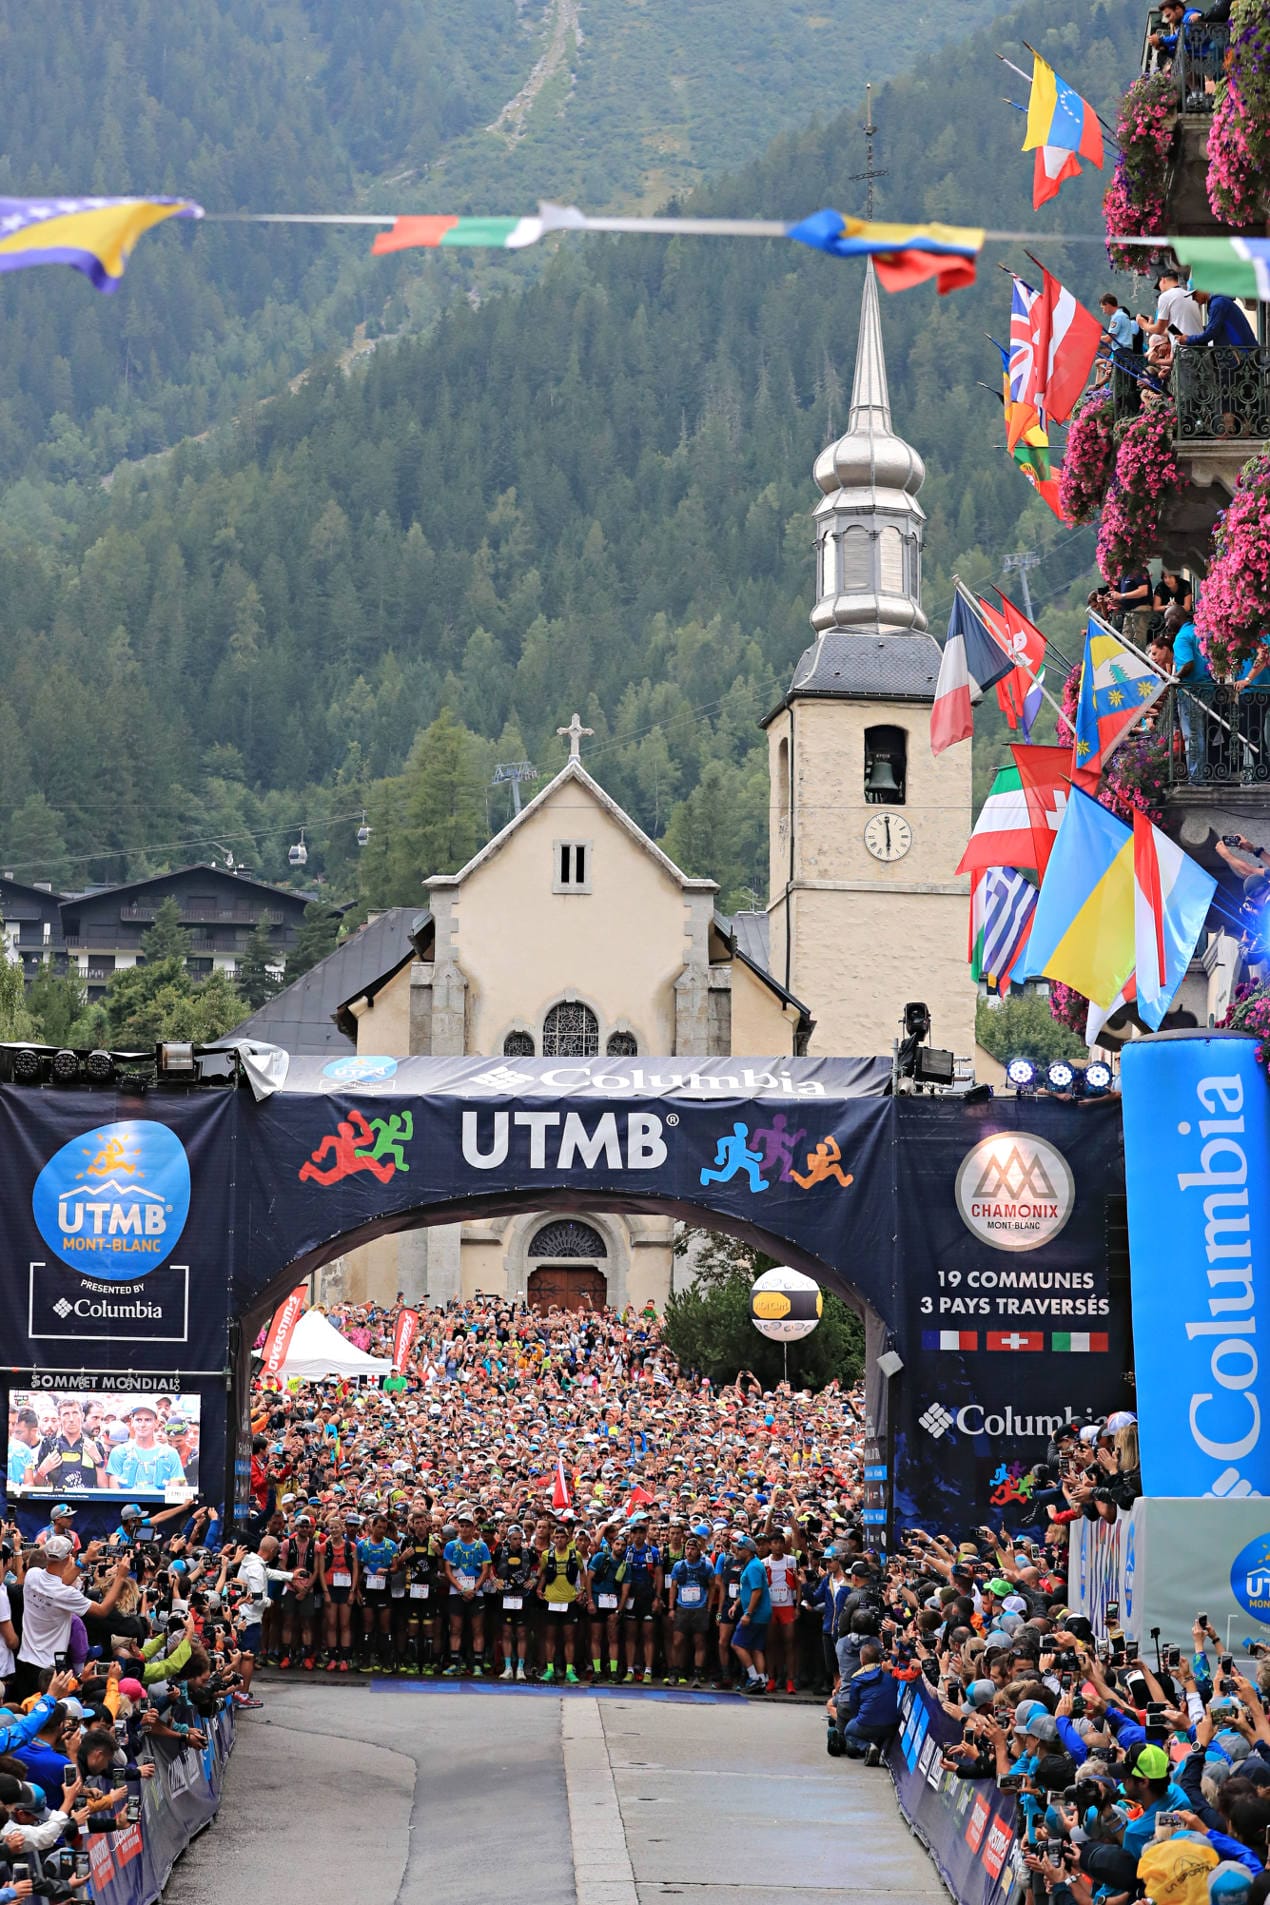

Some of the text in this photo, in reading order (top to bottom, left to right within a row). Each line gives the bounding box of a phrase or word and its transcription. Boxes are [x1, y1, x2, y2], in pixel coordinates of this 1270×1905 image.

[540, 1068, 827, 1096] Columbia
[971, 1203, 1058, 1218] CHAMONIX
[987, 1221, 1041, 1230] MONT-BLANC
[63, 1237, 160, 1252] MONT-BLANC
[1177, 1073, 1262, 1461] Columbia
[80, 1279, 145, 1294] PRESENTED BY
[937, 1270, 1094, 1289] 19 COMMUNES
[73, 1299, 163, 1319] Columbia
[920, 1294, 1110, 1315] 3 PAYS TRAVERSÉS
[32, 1375, 176, 1390] SOMMET MONDIAL
[956, 1405, 1108, 1437] Colum
